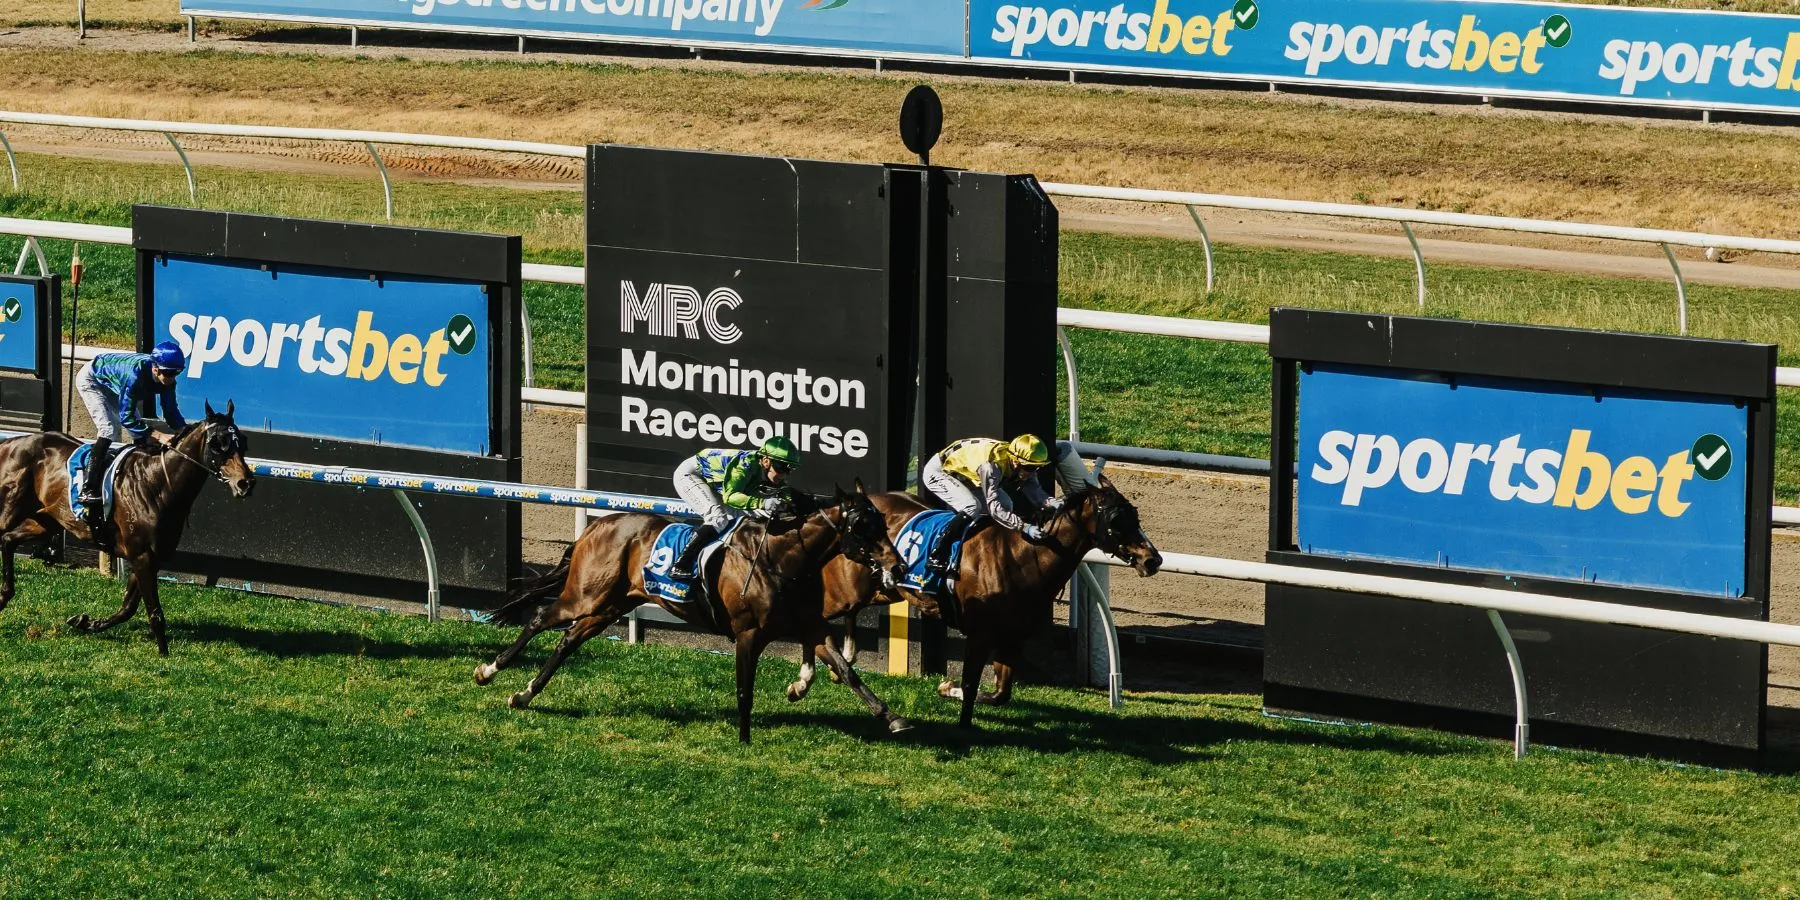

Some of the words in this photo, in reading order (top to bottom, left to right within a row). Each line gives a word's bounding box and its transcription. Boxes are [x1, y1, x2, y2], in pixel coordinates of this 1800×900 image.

[991, 0, 1235, 57] sportsbet
[1284, 15, 1547, 76] sportsbet
[1598, 31, 1800, 95] sportsb
[620, 280, 743, 345] MRC
[168, 310, 450, 387] sportsbet
[621, 347, 866, 411] Mornington
[621, 396, 869, 459] Racecourse
[270, 467, 313, 480] sportsbet
[323, 472, 368, 487] sportsbet
[378, 476, 423, 489] sportsbet
[433, 480, 478, 493] sportsbet
[493, 486, 539, 499] sportsbet
[550, 491, 597, 505] sportsbet
[607, 495, 655, 510] sportsbet
[1311, 428, 1697, 518] sportsbet
[651, 545, 674, 577] 9
[896, 529, 924, 566] 6
[645, 580, 688, 598] sportsbet
